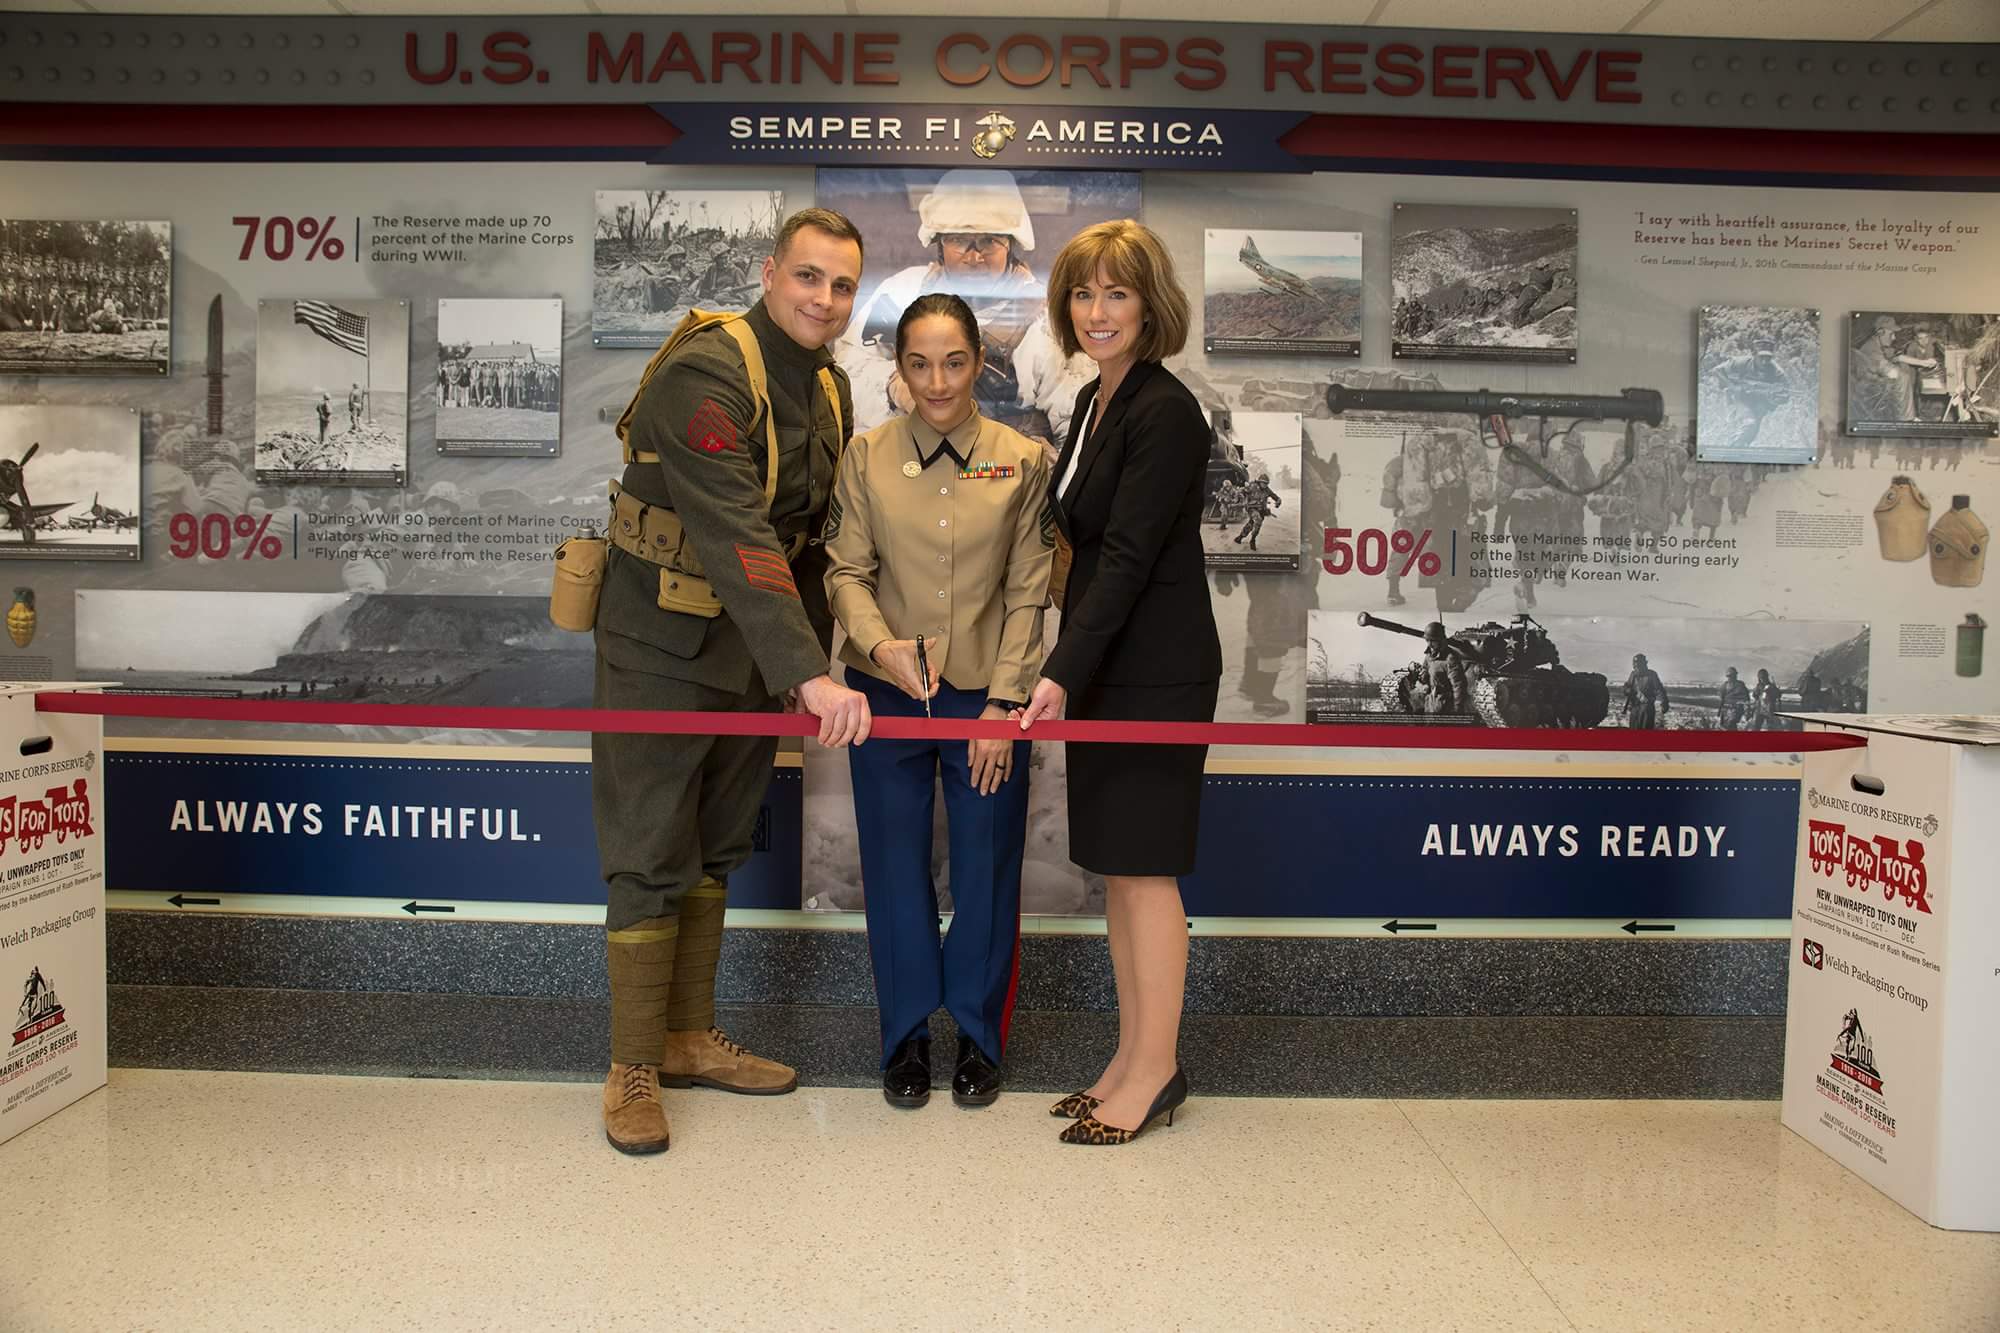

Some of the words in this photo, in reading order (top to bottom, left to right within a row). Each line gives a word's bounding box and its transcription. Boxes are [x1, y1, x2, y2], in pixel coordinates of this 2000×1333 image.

[405, 31, 549, 85] U.S.
[587, 31, 899, 85] MARINE
[936, 32, 1227, 91] CORPS
[1264, 40, 1643, 103] RESERVE
[730, 116, 902, 140] SEMPER
[926, 119, 960, 140] FI
[1027, 119, 1223, 144] AMERICA
[372, 216, 399, 228] The
[403, 216, 461, 228] Reserve
[465, 216, 505, 228] made
[509, 219, 528, 231] up
[533, 216, 552, 228] 70
[1648, 216, 1674, 229] say
[1678, 214, 1711, 228] with
[1715, 214, 1776, 229] heartfelt
[1780, 219, 1851, 233] assurance,
[1856, 218, 1877, 232] the
[1881, 219, 1933, 236] loyalty
[1938, 220, 1953, 234] of
[1956, 223, 1981, 235] our
[232, 216, 345, 261] 70%
[372, 234, 427, 247] percent
[431, 232, 447, 245] of
[451, 233, 474, 245] the
[478, 233, 527, 245] Marine
[531, 233, 575, 248] Corps
[1634, 231, 1686, 246] Reserve
[1692, 231, 1715, 246] has
[1719, 232, 1753, 247] been
[1757, 234, 1779, 248] the
[1848, 236, 1889, 251] Secret
[372, 250, 417, 264] during
[423, 250, 467, 262] WWII.
[1640, 255, 1659, 265] Gen
[1661, 256, 1697, 267] Lemuel
[1858, 261, 1873, 272] the
[308, 513, 355, 527] During
[360, 514, 400, 525] WWII
[404, 514, 424, 526] 90
[428, 516, 484, 529] percent
[488, 514, 505, 526] of
[507, 515, 555, 527] Marine
[560, 515, 603, 529] Corps
[169, 513, 282, 561] 90%
[307, 531, 365, 543] aviators
[368, 531, 399, 543] who
[403, 532, 452, 544] earned
[456, 532, 480, 544] the
[484, 532, 541, 545] combat
[1471, 531, 1529, 545] Reserve
[1533, 533, 1589, 546] Marines
[1593, 534, 1633, 547] made
[1636, 537, 1656, 551] up
[1658, 536, 1678, 548] 50
[1682, 538, 1737, 552] percent
[402, 551, 437, 561] were
[440, 549, 475, 561] from
[479, 549, 503, 561] the
[507, 550, 558, 562] Reserv
[1322, 528, 1441, 577] 50%
[1470, 549, 1486, 561] of
[1489, 549, 1513, 562] the
[1517, 550, 1536, 562] 1st
[1540, 551, 1589, 563] Marine
[1593, 552, 1650, 565] Division
[1654, 553, 1700, 568] during
[1704, 554, 1740, 569] early
[1469, 566, 1520, 579] battles
[1523, 567, 1538, 580] of
[1543, 568, 1567, 580] the
[1570, 568, 1622, 582] Korean
[1626, 570, 1660, 583] War.
[22, 765, 50, 779] CORPS
[51, 757, 85, 774] RESERVE
[20, 807, 47, 831] FOR
[54, 802, 85, 825] TOTS
[169, 799, 324, 836] ALWAYS
[344, 803, 542, 842] FAITHFUL.
[1818, 794, 1850, 812] MARINE
[1851, 802, 1879, 819] CORPS
[1880, 808, 1922, 830] RESERVE
[1421, 823, 1580, 857] ALWAYS
[1600, 824, 1735, 858] READY.
[7, 859, 51, 881] UNWRAPPED
[52, 853, 69, 868] TOYS
[70, 848, 86, 863] ONLY
[1812, 830, 1841, 858] TOYS
[1848, 843, 1874, 875] FOR
[1882, 857, 1921, 894] TOTS
[22, 875, 41, 887] RUNS
[47, 868, 58, 880] OCT
[1816, 887, 1833, 903] NEW,
[1834, 894, 1876, 919] UNWRAPPED
[1877, 909, 1896, 927] TOYS
[1898, 917, 1918, 933] ONLY
[1816, 901, 1845, 918] CAMPAIGN
[1846, 912, 1864, 926] RUNS
[1870, 920, 1884, 933] OCT
[1901, 932, 1916, 945] DEC
[0, 928, 29, 950] Welch
[30, 915, 72, 940] Packaging
[72, 906, 96, 923] Group
[1922, 958, 1941, 973] Series
[1825, 953, 1850, 976] Welch
[1851, 965, 1896, 999] Packaging
[1897, 985, 1929, 1012] Group
[39, 990, 55, 1013] 100
[26, 1046, 48, 1065] CORPS
[49, 1031, 78, 1052] RESERVE
[1856, 1043, 1873, 1068] 100
[1816, 1074, 1840, 1096] MARINE
[1841, 1089, 1863, 1110] CORPS
[1865, 1103, 1896, 1130] RESERVE
[1816, 1084, 1858, 1115] CELEBRATING
[1872, 1119, 1897, 1139] YEARS
